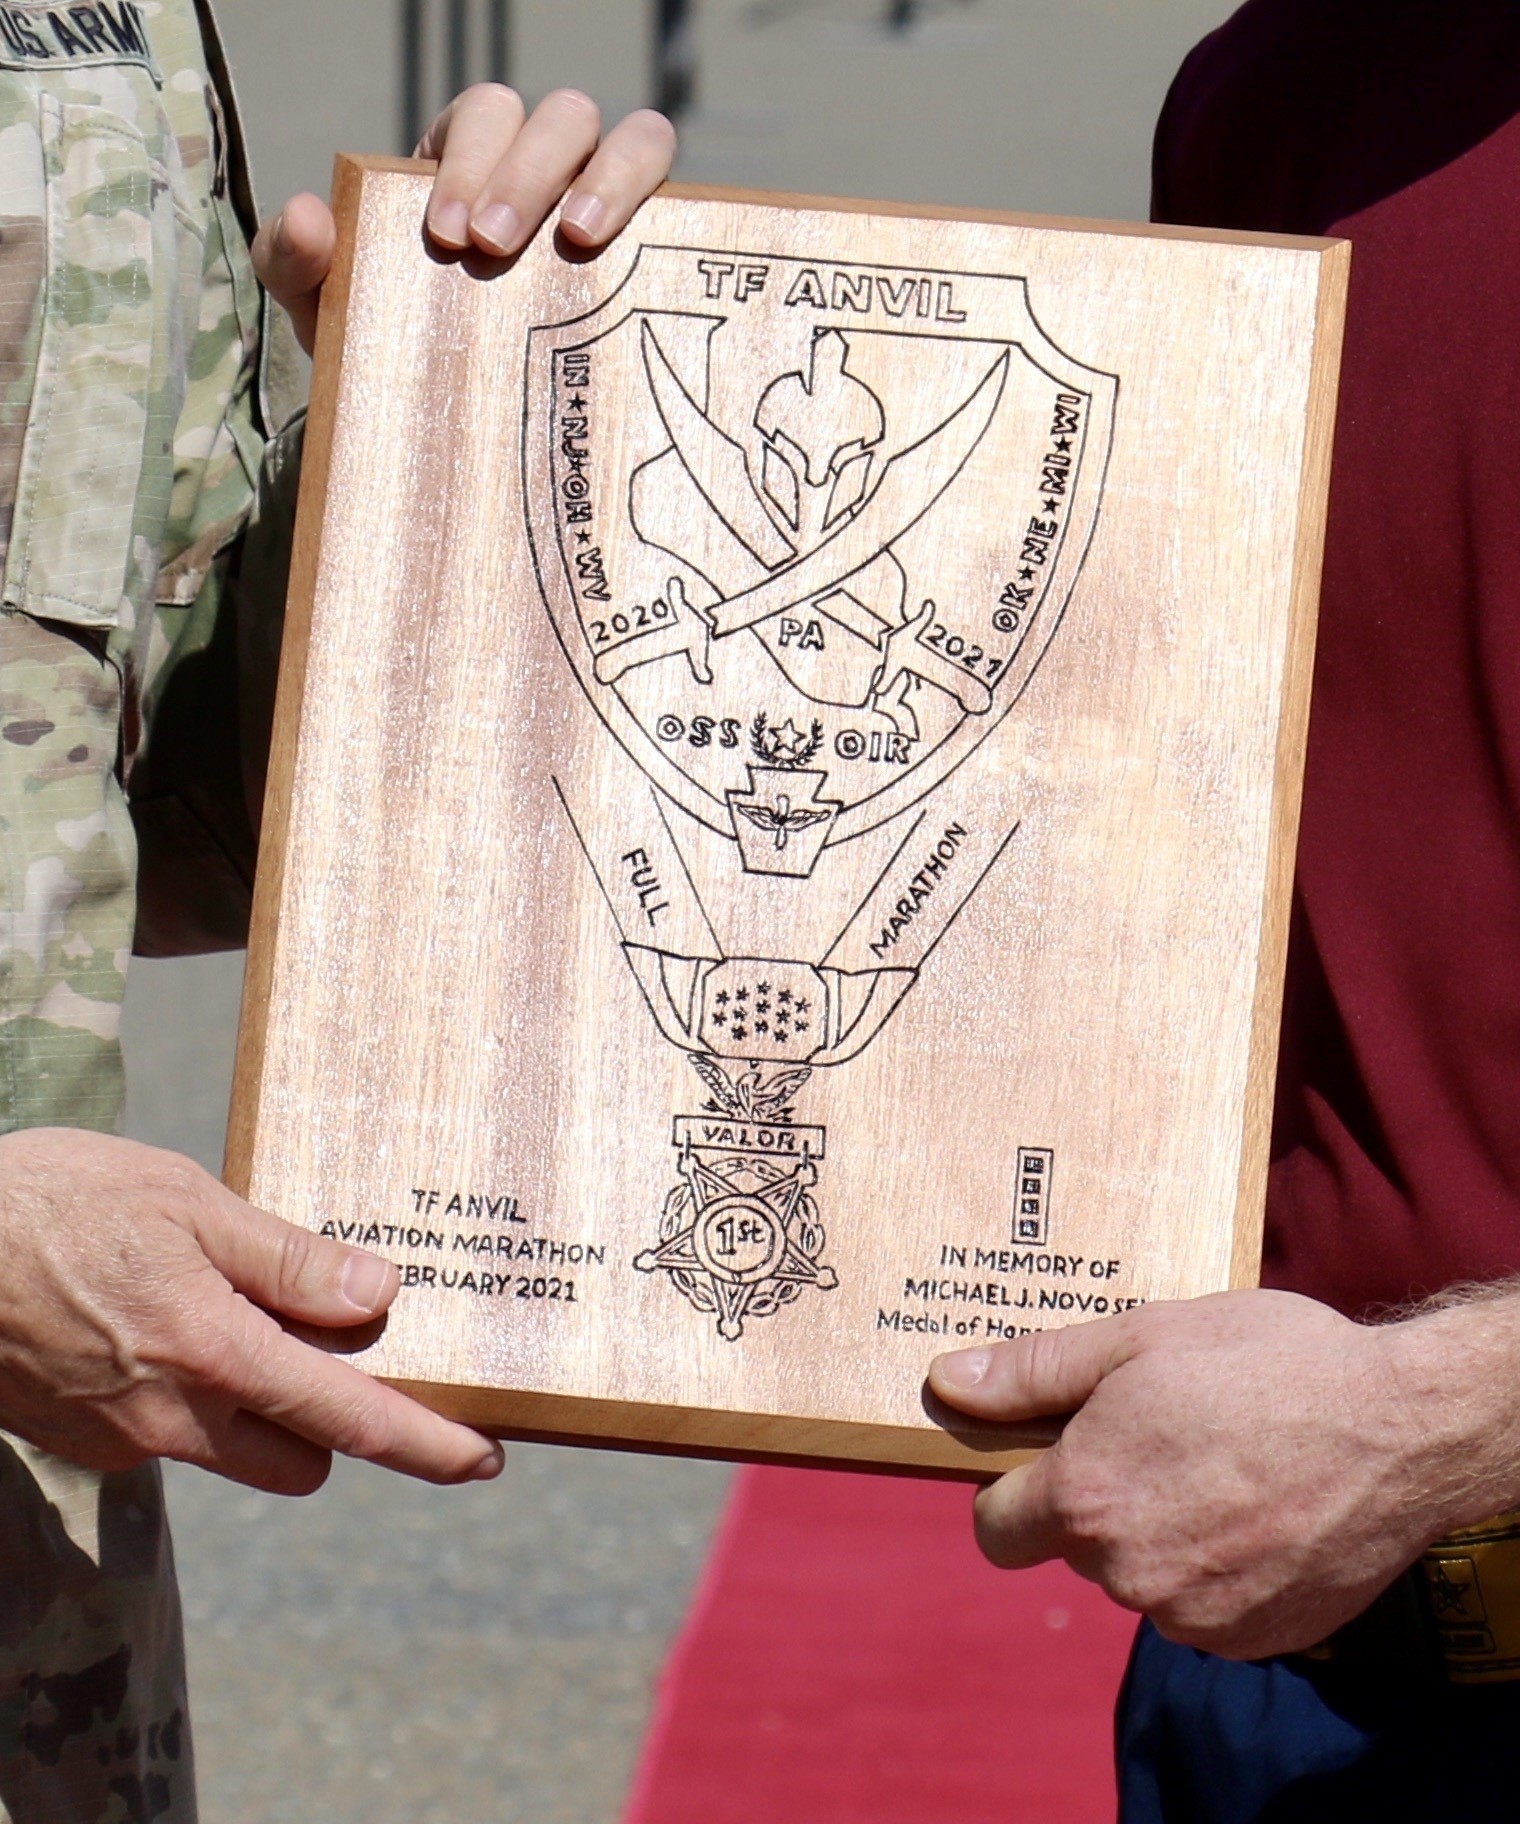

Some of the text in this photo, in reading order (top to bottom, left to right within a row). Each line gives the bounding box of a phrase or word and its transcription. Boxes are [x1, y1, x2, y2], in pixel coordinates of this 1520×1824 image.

[697, 259, 967, 323] TF ANVIL
[590, 598, 669, 643] 2020
[779, 618, 825, 651] PA
[926, 624, 1003, 678] 2021
[656, 715, 910, 765] OSS OIR
[621, 848, 671, 928] FULL
[870, 821, 967, 959] MARATHON
[703, 1126, 796, 1151] VALOR
[411, 1189, 527, 1223] TF ANVIL
[320, 1219, 606, 1266] AVIATION MARATHON
[716, 1217, 766, 1256] 1st
[940, 1245, 1121, 1279] IN MEMORY OF
[396, 1264, 579, 1302] BRUARY 2021
[1038, 1287, 1146, 1315] NOVOSE
[877, 1308, 948, 1335] Medal
[956, 1317, 983, 1339] of
